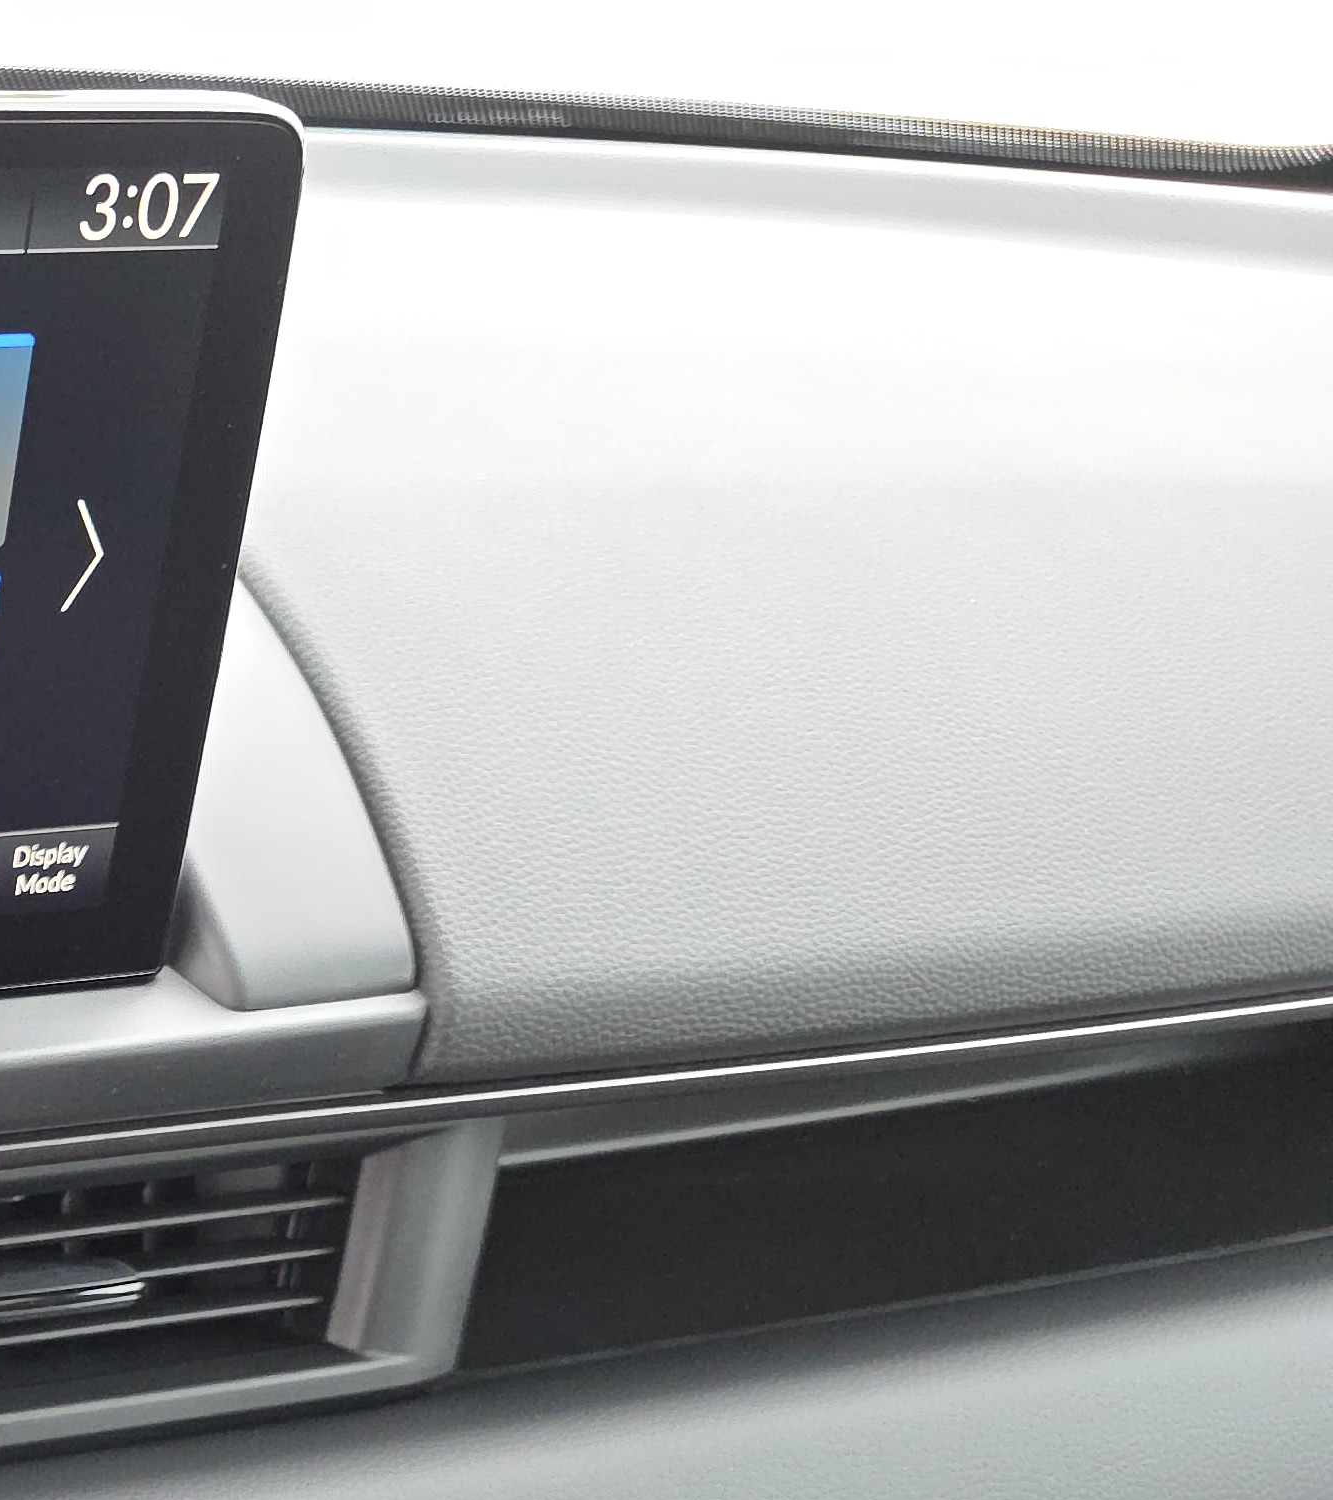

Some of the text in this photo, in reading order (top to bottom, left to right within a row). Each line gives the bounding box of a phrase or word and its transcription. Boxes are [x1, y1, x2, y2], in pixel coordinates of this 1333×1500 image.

[79, 172, 221, 241] 3:07
[12, 841, 90, 870] Display
[13, 866, 77, 897] Mode
